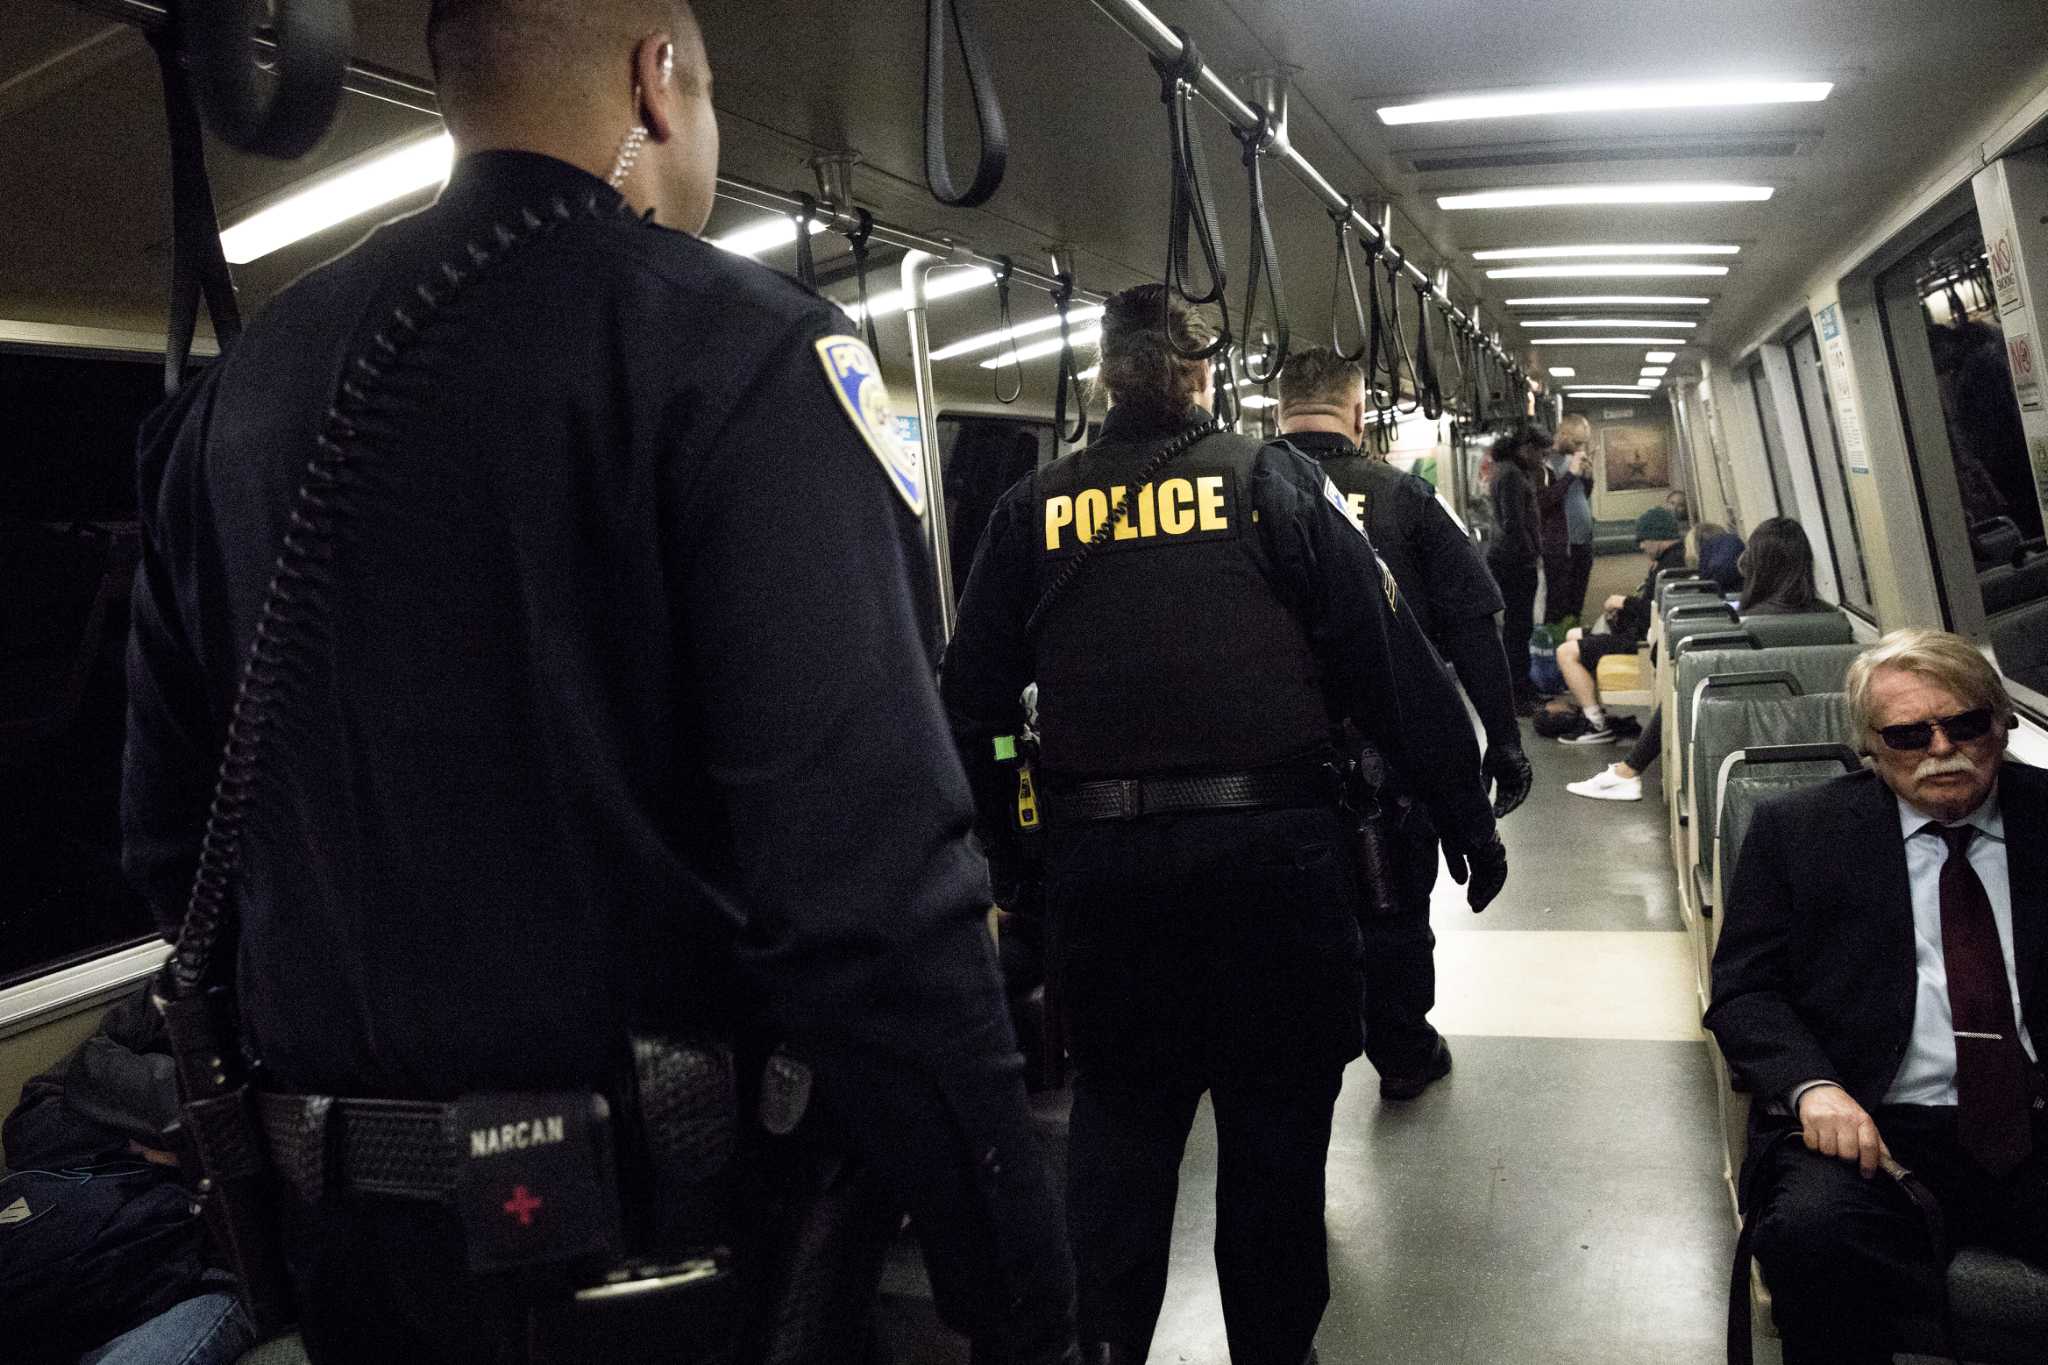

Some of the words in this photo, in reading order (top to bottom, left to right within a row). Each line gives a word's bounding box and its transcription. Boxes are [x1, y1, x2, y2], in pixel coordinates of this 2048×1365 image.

[1992, 239, 2011, 278] NO
[2009, 340, 2032, 376] NO
[1045, 476, 1228, 550] POLICE
[470, 1115, 565, 1158] NARCAN
